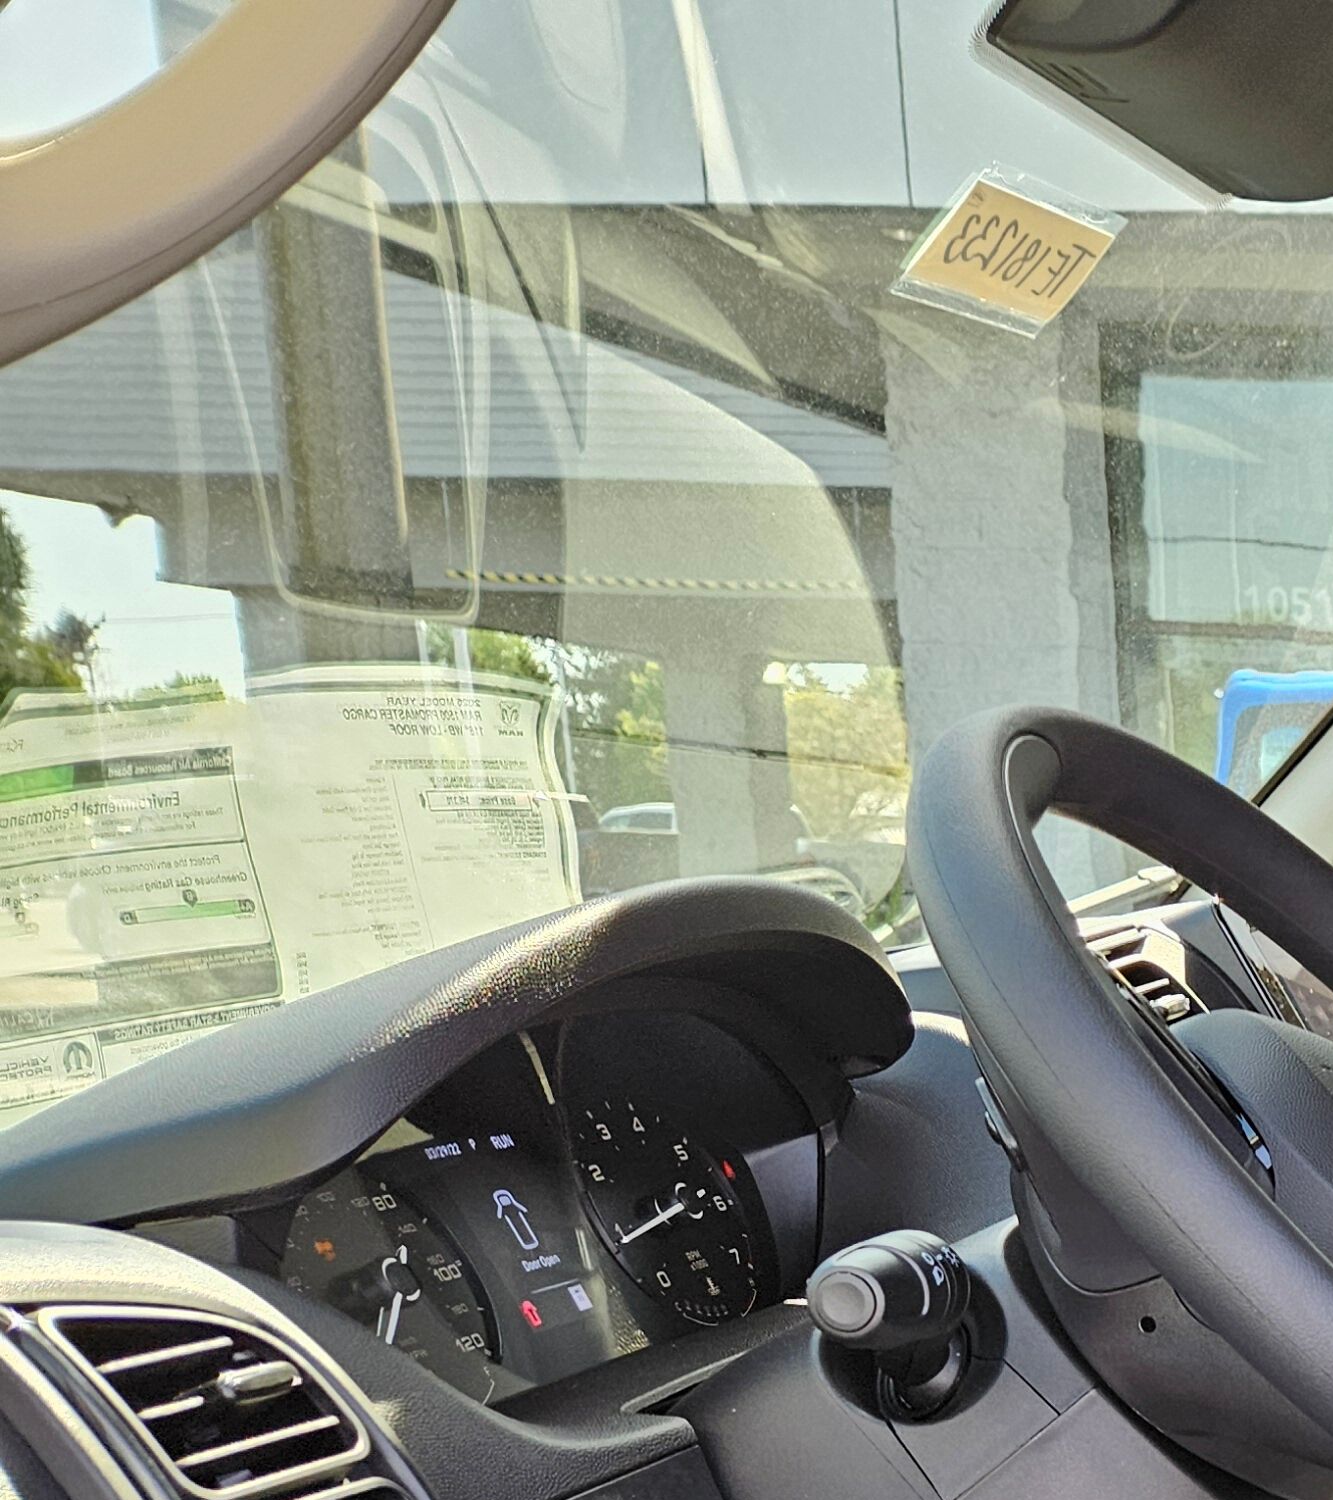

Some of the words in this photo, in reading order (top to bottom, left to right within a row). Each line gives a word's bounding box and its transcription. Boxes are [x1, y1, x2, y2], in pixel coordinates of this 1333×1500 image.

[596, 1123, 612, 1141] 3
[632, 1116, 646, 1133] 4
[490, 1133, 515, 1151] RUN
[673, 1144, 689, 1161] 5
[588, 1164, 605, 1182] 2
[371, 1193, 398, 1212] 80
[712, 1195, 728, 1212] 6
[521, 1257, 541, 1272] Door
[540, 1253, 562, 1270] Open
[433, 1263, 463, 1283] 100
[657, 1271, 672, 1288] 0
[455, 1332, 485, 1353] 120
